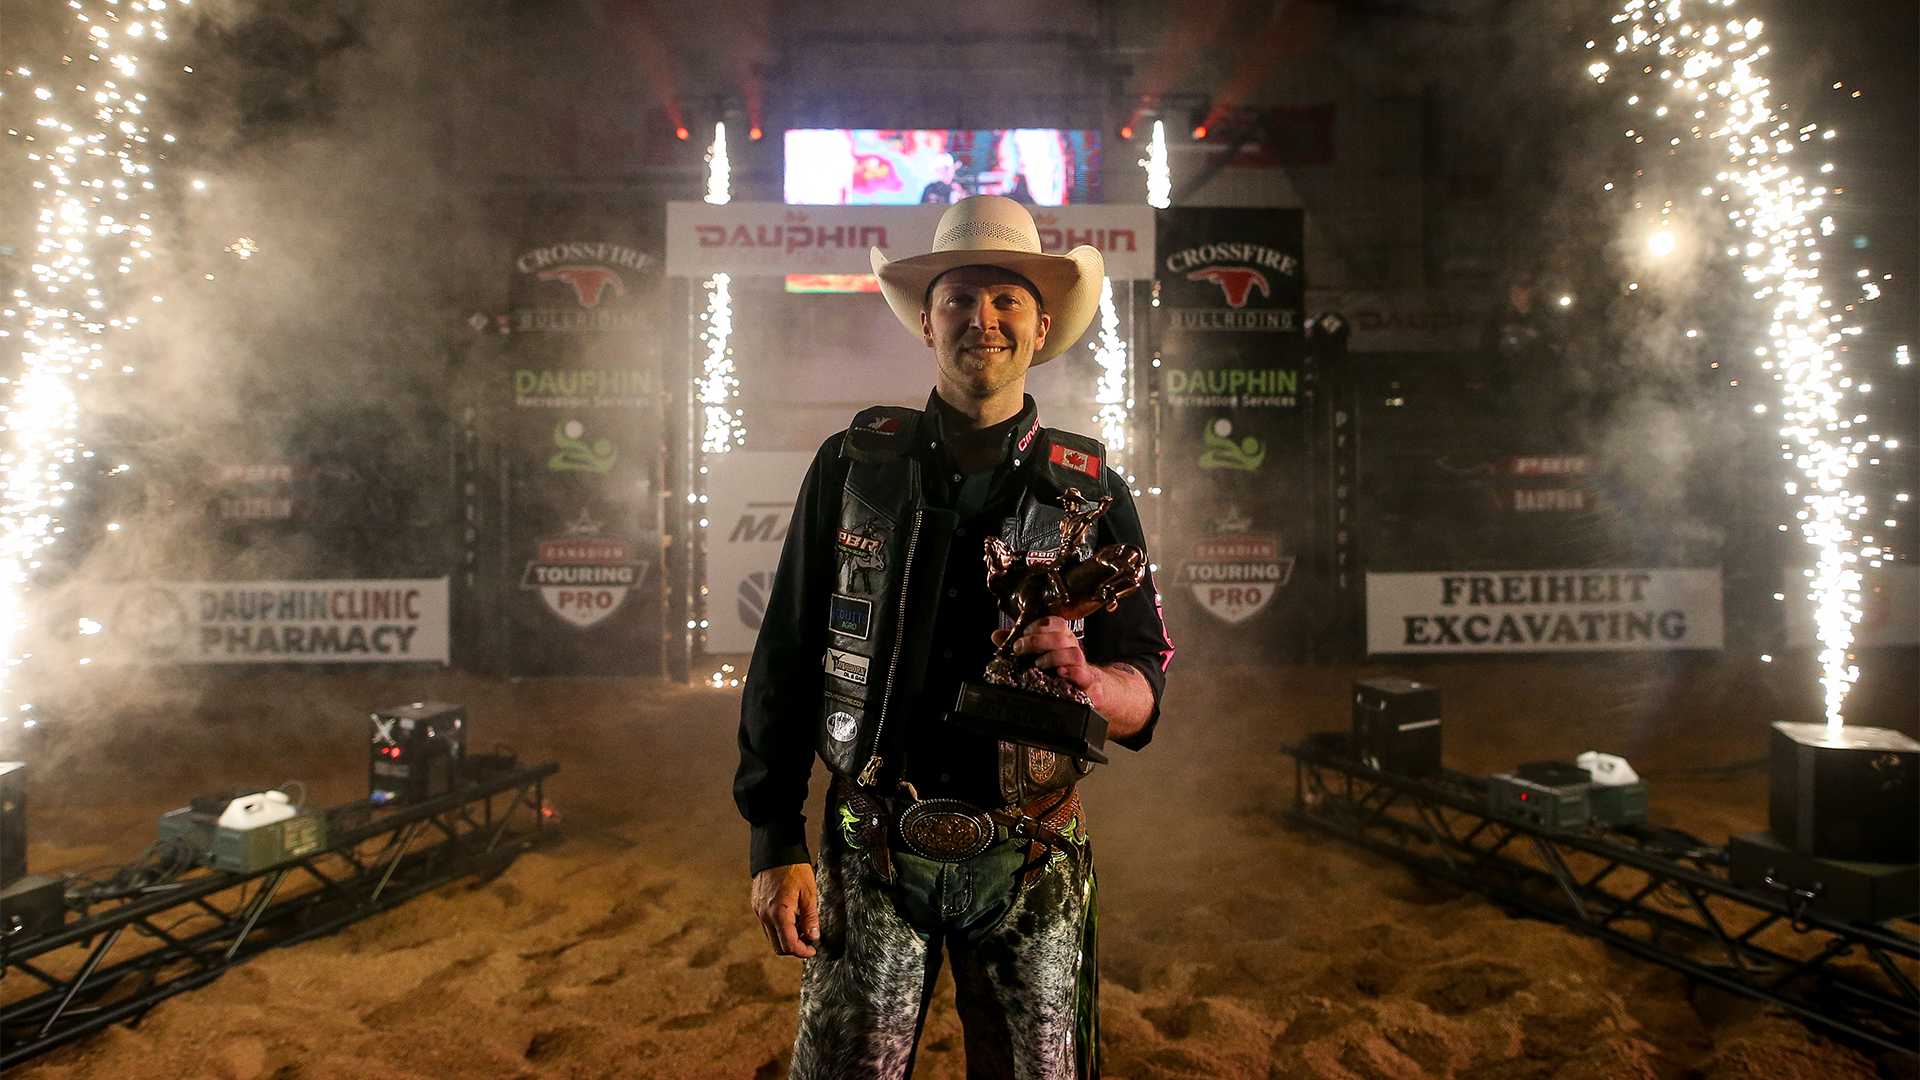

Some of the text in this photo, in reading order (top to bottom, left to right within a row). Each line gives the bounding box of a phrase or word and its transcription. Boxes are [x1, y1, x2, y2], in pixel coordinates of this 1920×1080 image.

[695, 223, 888, 254] DAUPHIN
[1041, 228, 1136, 251] PHIN
[517, 242, 652, 274] CROSSFIRE
[1166, 241, 1297, 275] CROSSFIRE
[1170, 311, 1294, 329] BULLRIDING
[515, 368, 652, 393] DAUPHIN
[1167, 369, 1296, 393] DAUPHIN
[1168, 395, 1296, 407] Recreation Services
[838, 531, 879, 551] PBR
[534, 567, 633, 583] TOURING
[1186, 564, 1281, 581] TOURING
[559, 591, 613, 609] PRO
[1209, 587, 1262, 606] PRO
[1442, 573, 1651, 605] FREIHEIT
[1403, 608, 1687, 645] EXCAVATING
[199, 626, 419, 654] PHARMACY
